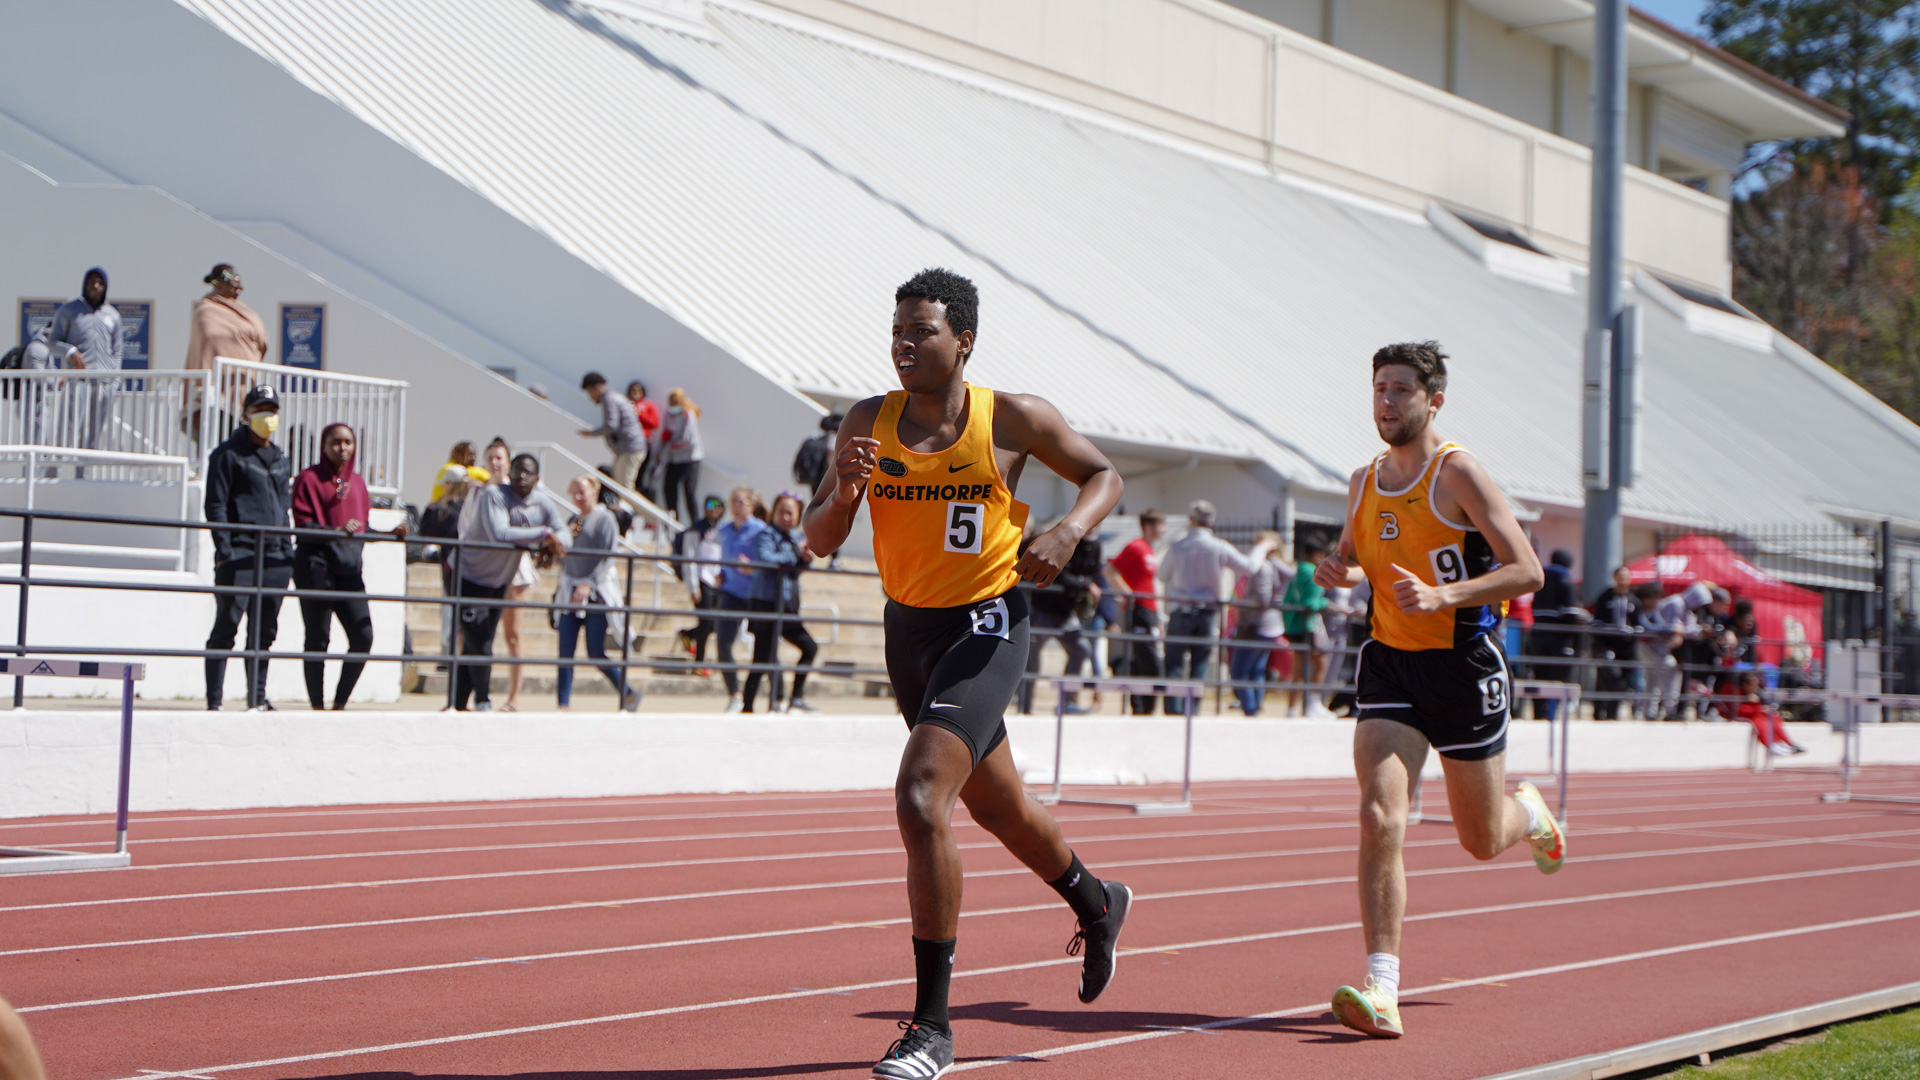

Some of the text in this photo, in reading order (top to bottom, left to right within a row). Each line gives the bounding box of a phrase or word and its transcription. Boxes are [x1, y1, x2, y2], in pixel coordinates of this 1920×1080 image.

[873, 483, 993, 501] OGLETHORPE
[949, 505, 977, 549] 5
[1436, 549, 1463, 584] 9
[977, 601, 1003, 634] 5
[1487, 677, 1503, 710] 9
